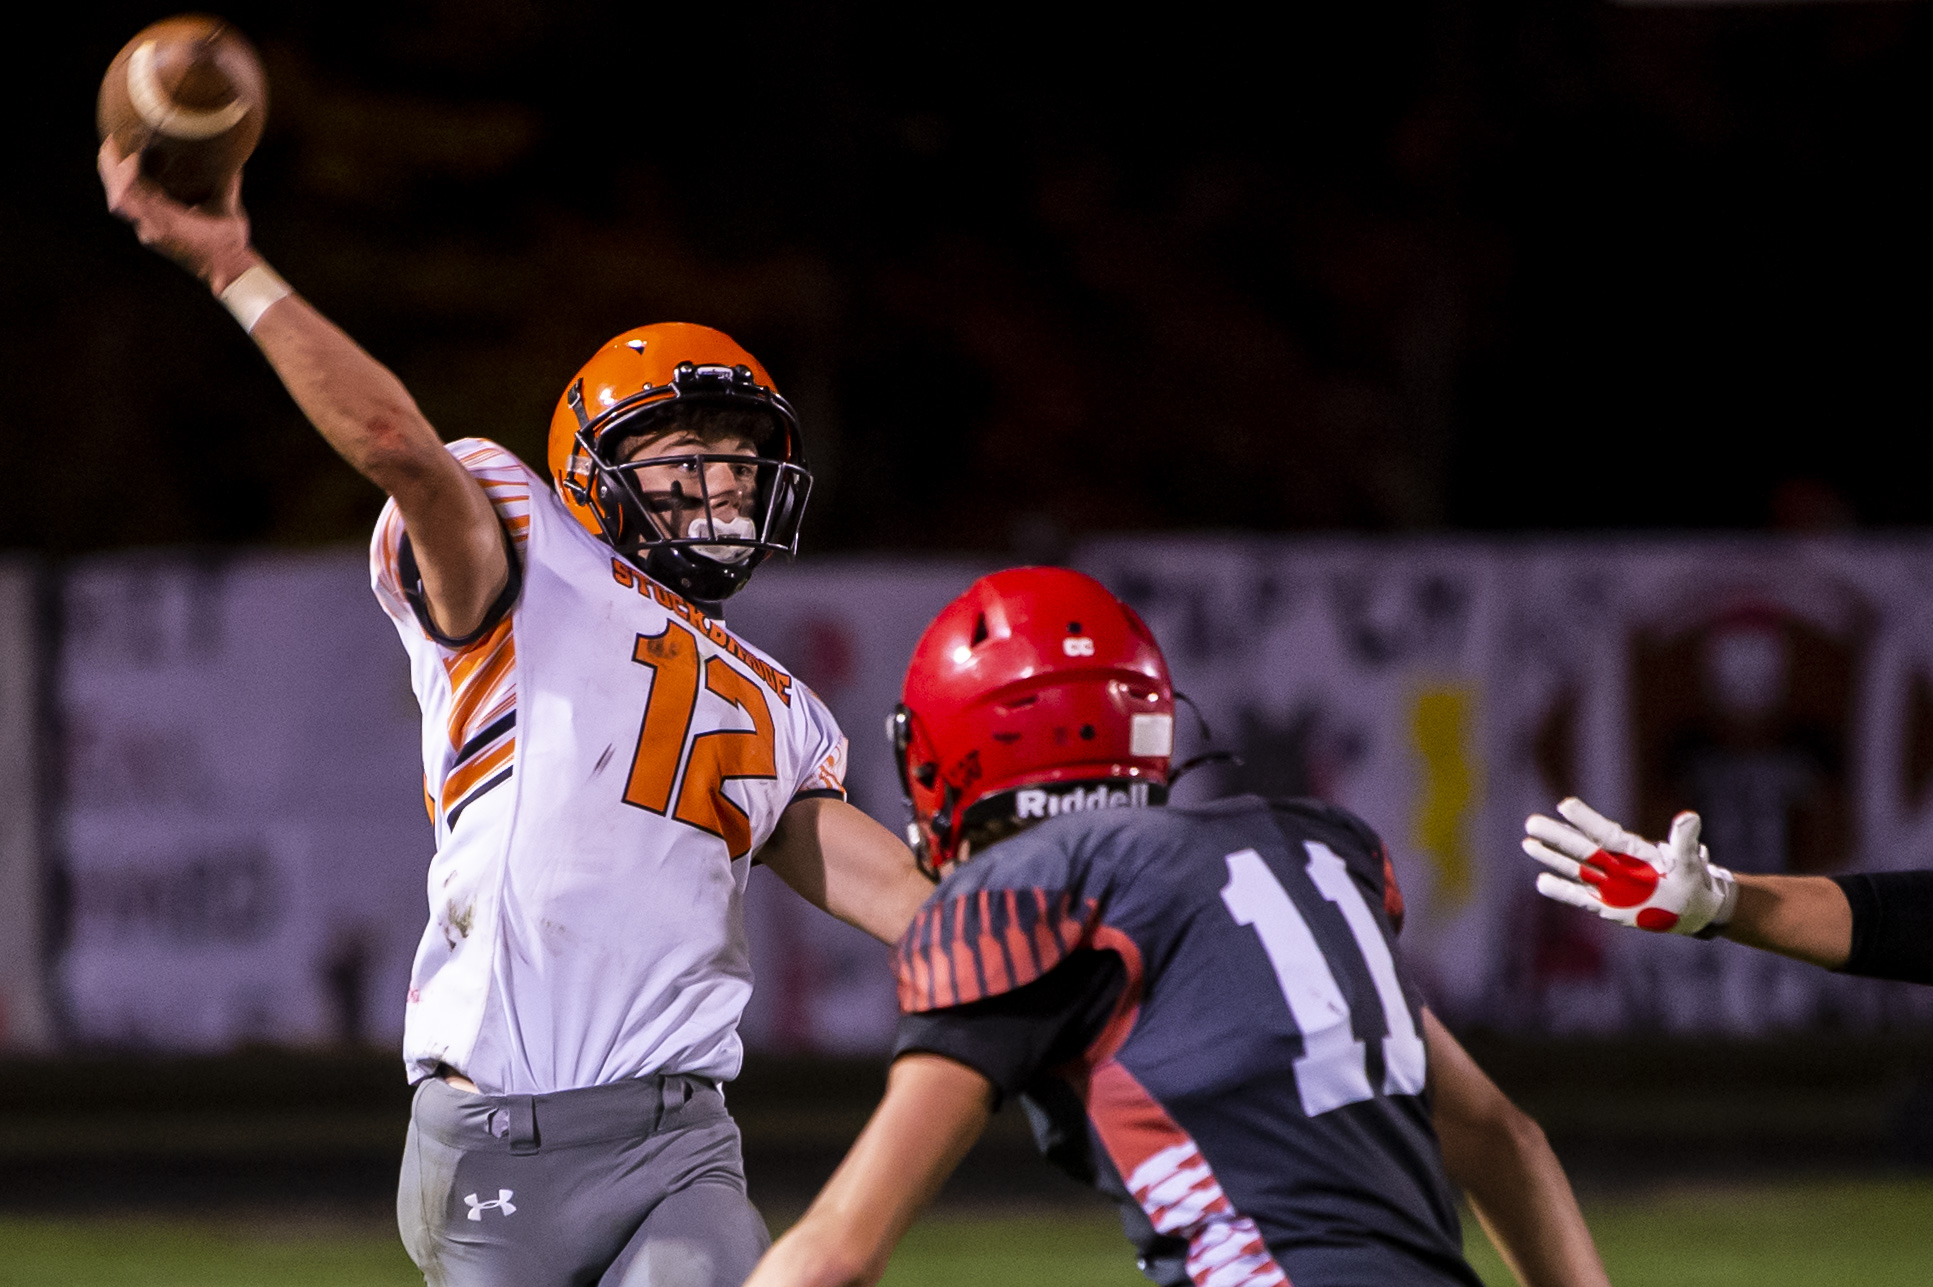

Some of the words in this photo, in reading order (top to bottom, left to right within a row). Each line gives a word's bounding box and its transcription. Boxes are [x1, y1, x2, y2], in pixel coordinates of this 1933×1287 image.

[621, 618, 777, 861] 12
[1016, 782, 1149, 818] Riddell
[1220, 840, 1426, 1117] 11
